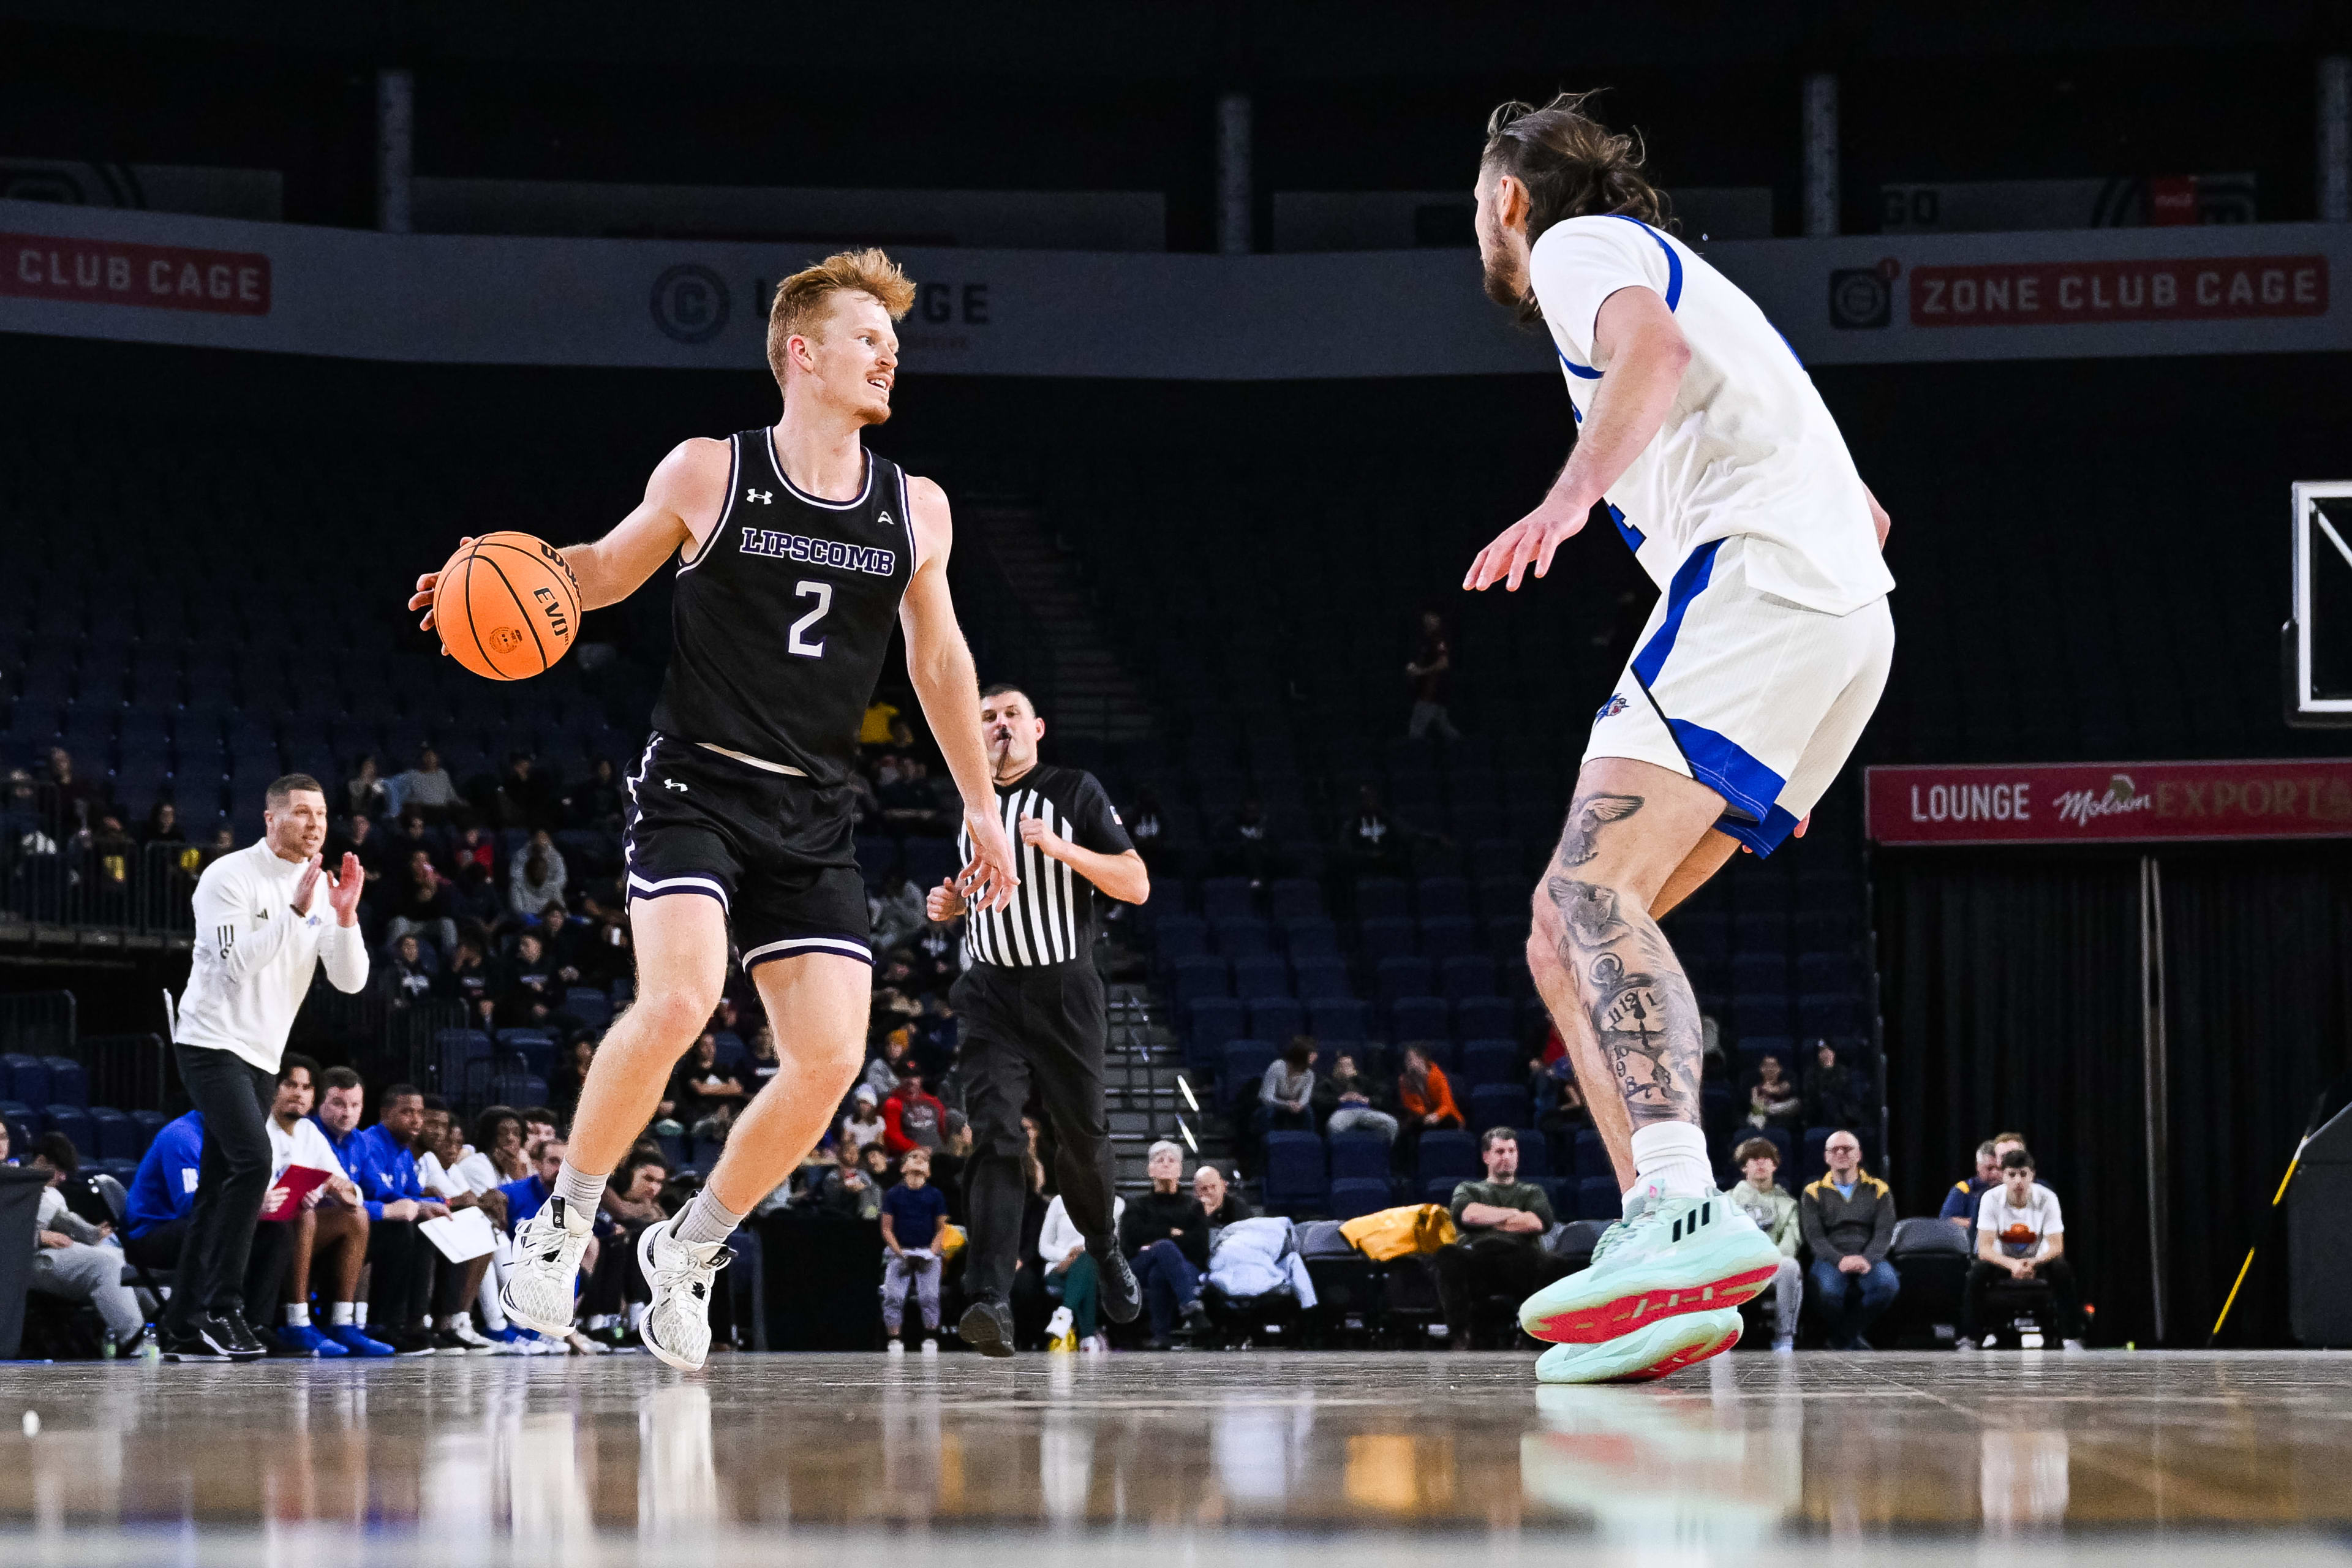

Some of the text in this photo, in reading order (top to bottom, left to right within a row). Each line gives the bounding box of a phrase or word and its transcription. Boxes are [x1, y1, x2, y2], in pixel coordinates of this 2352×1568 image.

[18, 249, 261, 303] CLUB CAGE
[1922, 267, 2317, 314] ZONE CLUB CAGE
[755, 278, 989, 324] LGE
[739, 526, 895, 576] LIPSCOMB
[787, 579, 833, 659] 2
[1910, 783, 2032, 823] LOUNGE
[2052, 788, 2152, 827] Molson
